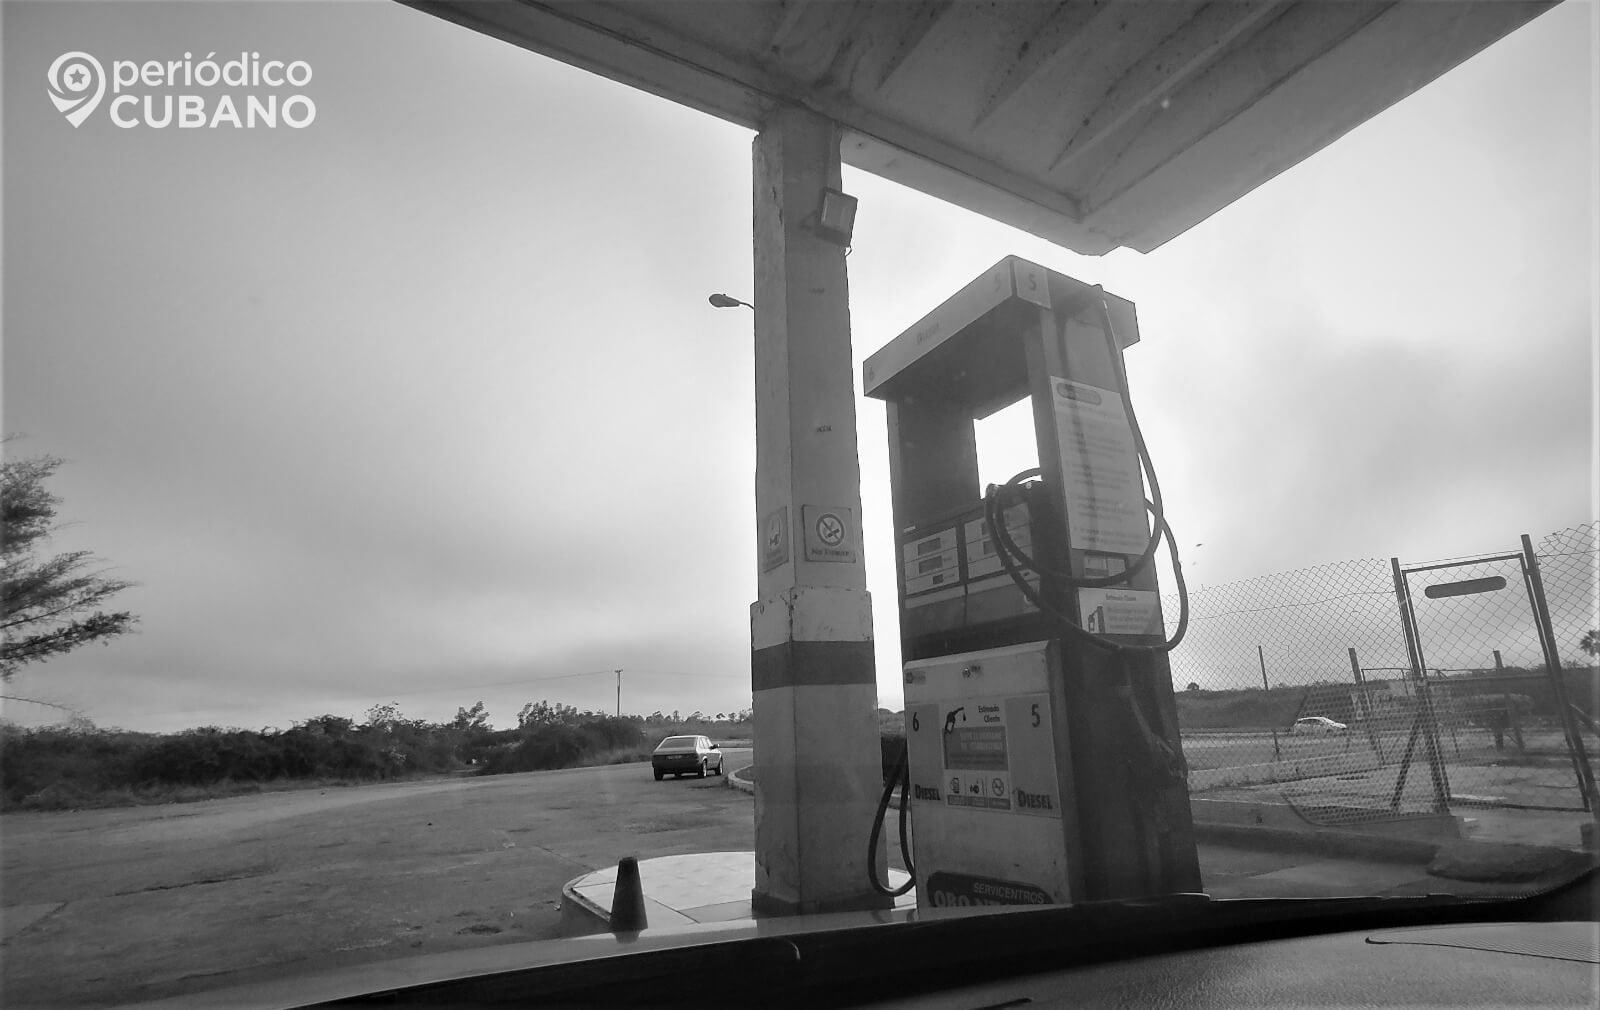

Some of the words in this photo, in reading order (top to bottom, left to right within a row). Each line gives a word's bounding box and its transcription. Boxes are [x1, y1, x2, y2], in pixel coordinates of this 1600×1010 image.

[912, 712, 920, 732] 6
[1031, 704, 1041, 728] 5
[973, 882, 1045, 905] SERVICENTROS
